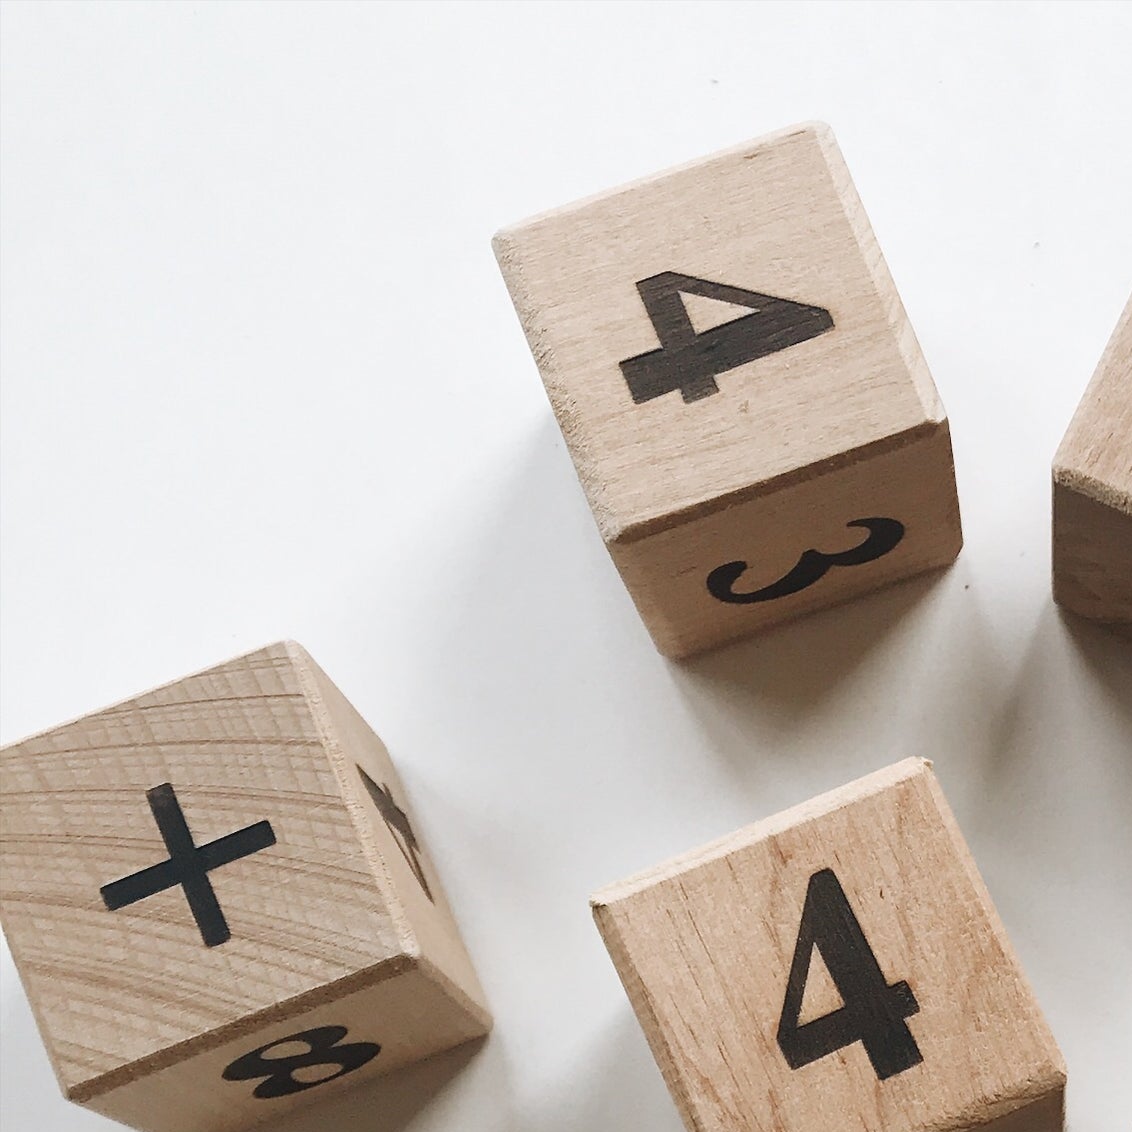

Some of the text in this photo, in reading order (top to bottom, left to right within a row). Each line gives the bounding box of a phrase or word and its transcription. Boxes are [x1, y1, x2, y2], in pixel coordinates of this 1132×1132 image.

[619, 270, 835, 403] 4
[706, 517, 904, 604] 3
[777, 868, 924, 1080] 4
[221, 1025, 382, 1099] 8
